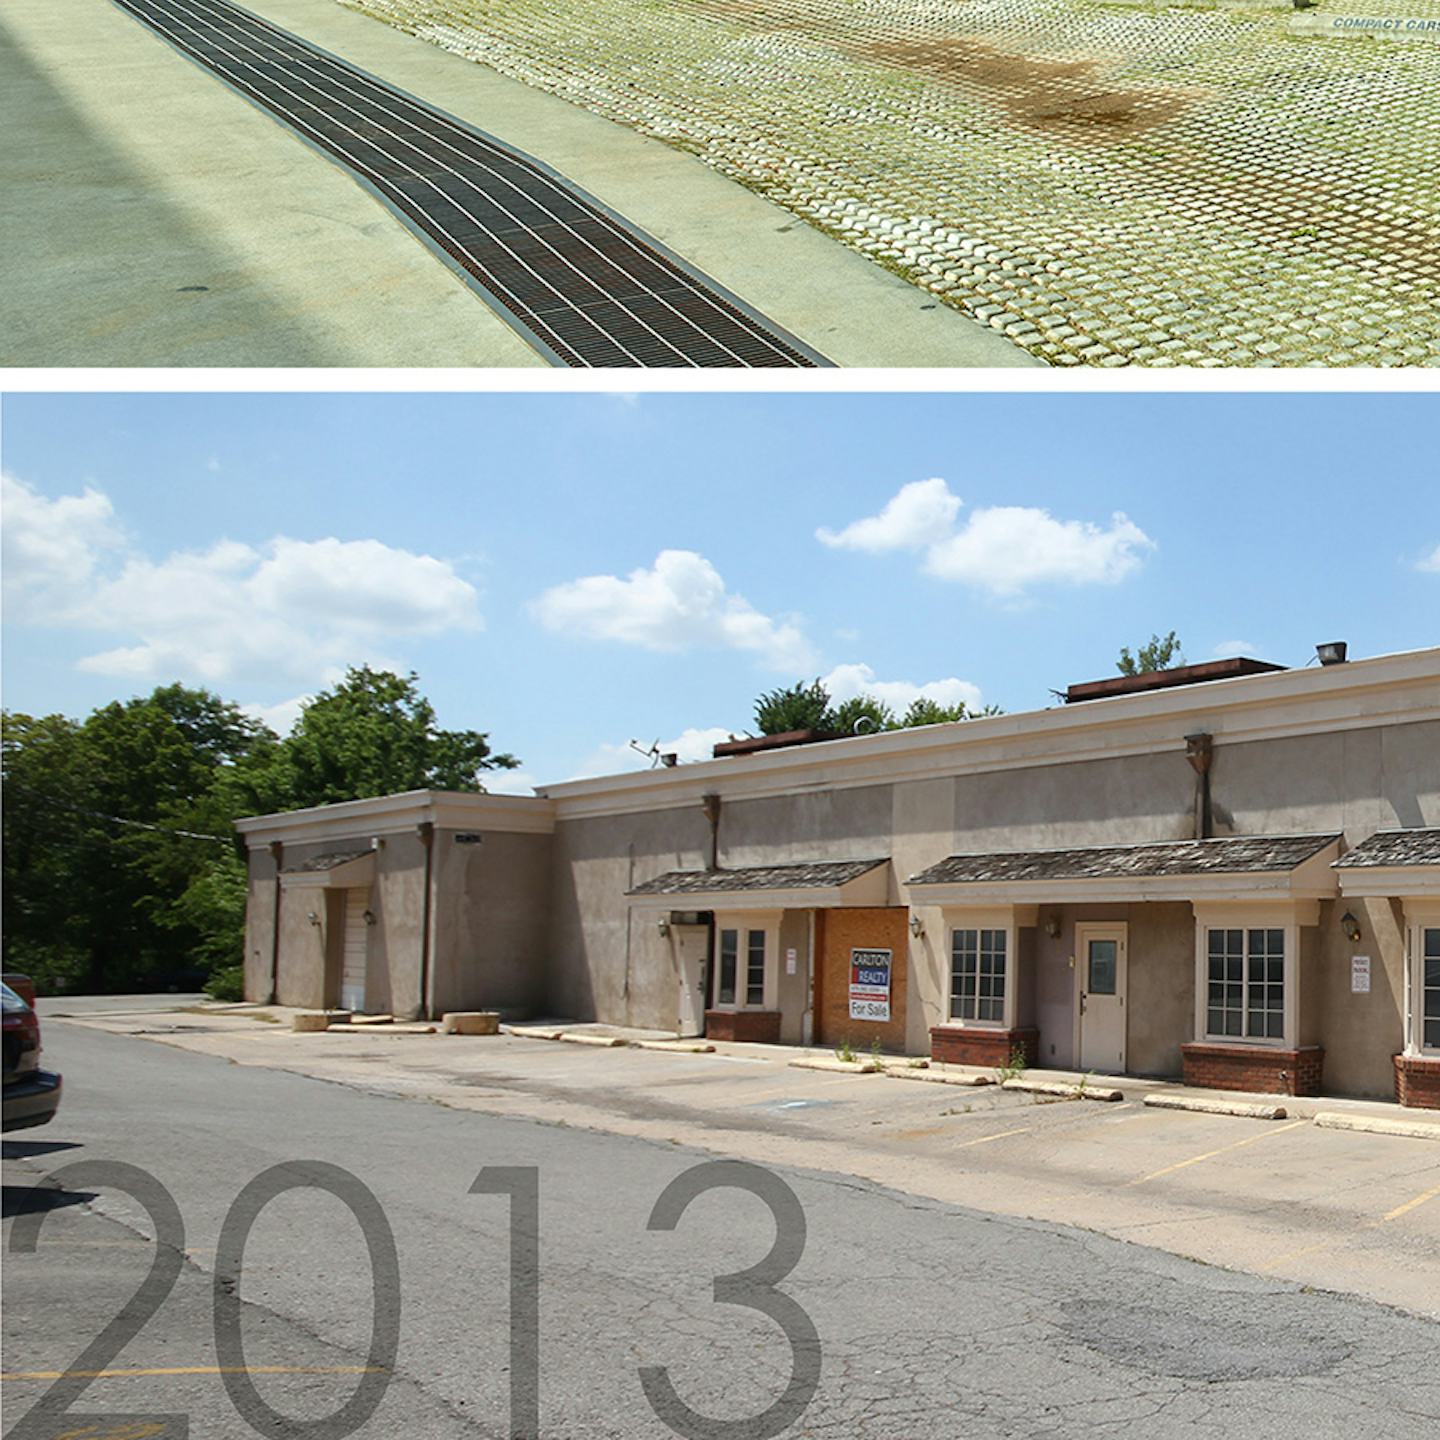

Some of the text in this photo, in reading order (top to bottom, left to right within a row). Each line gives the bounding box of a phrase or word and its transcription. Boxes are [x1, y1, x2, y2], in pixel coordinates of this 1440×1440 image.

[1333, 17, 1403, 29] COMPACT
[858, 970, 887, 983] REALTY
[852, 1002, 887, 1017] For Sale
